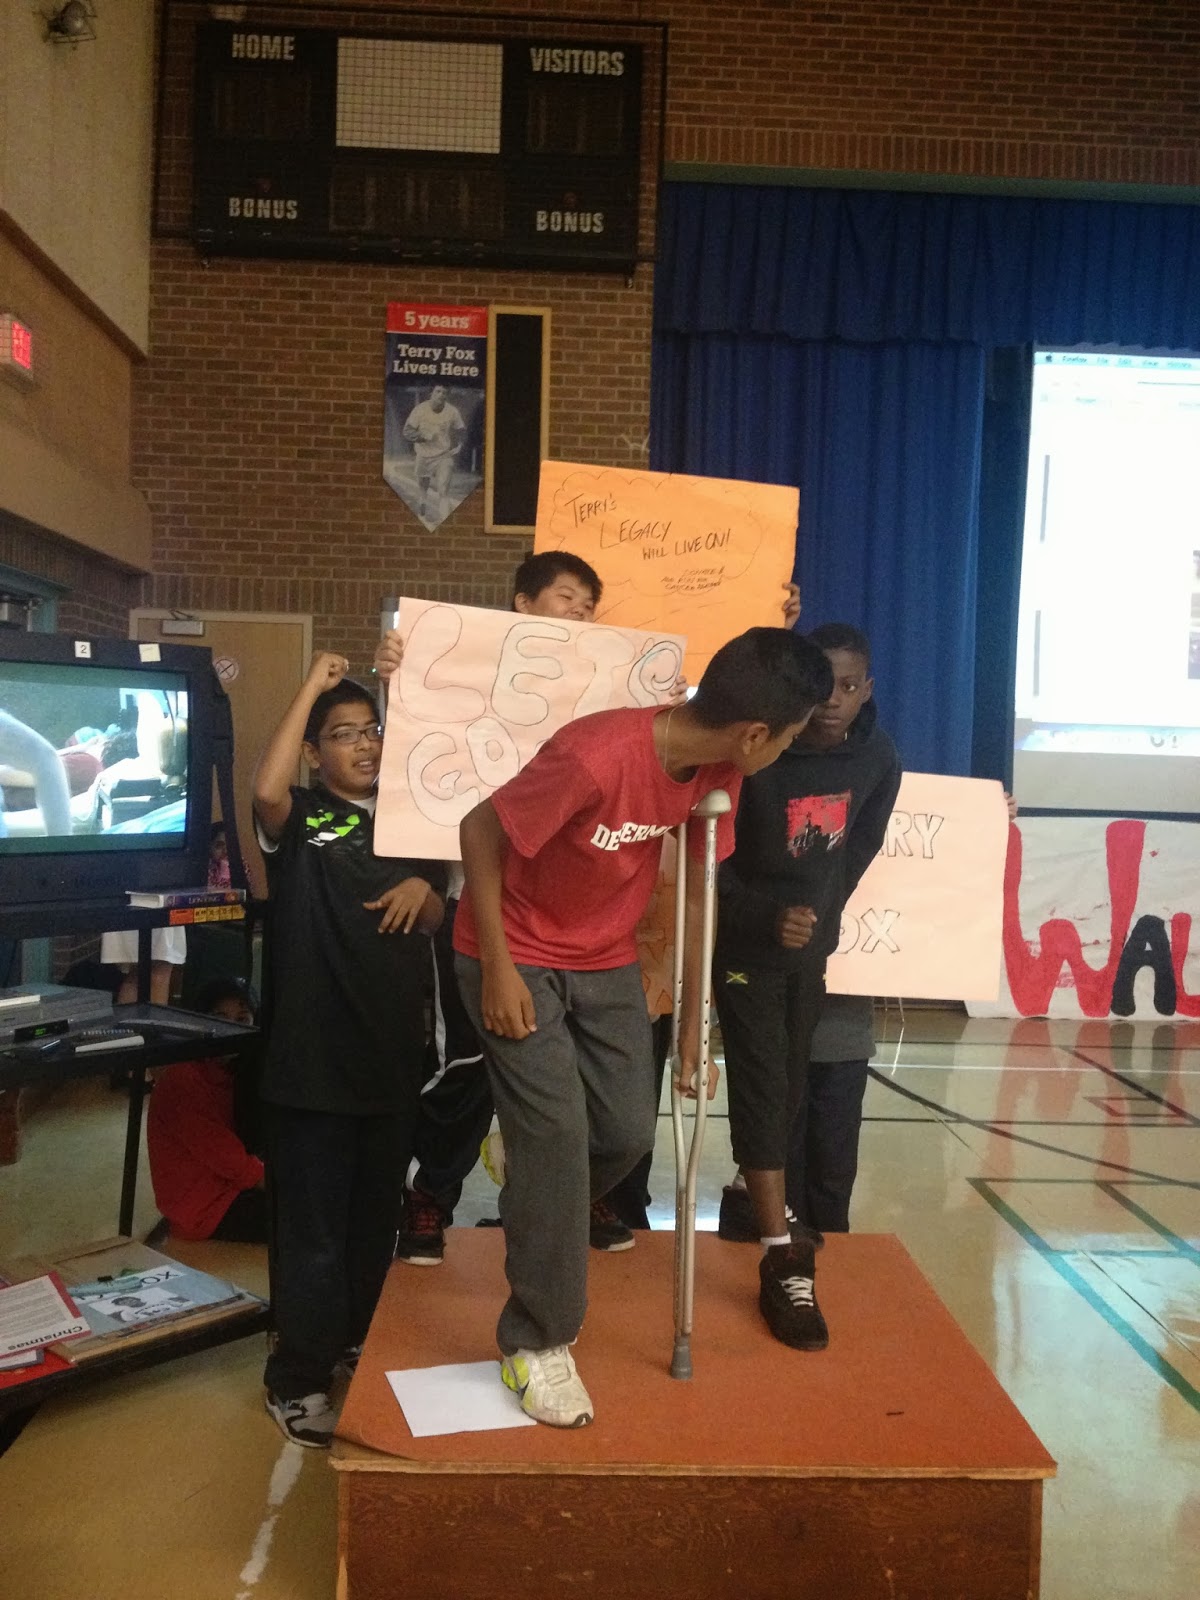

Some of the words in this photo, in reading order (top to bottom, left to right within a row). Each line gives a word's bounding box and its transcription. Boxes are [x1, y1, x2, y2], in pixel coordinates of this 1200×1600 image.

[231, 33, 295, 61] HOME
[530, 47, 625, 76] VISITORS
[228, 197, 298, 220] BONUS
[536, 210, 604, 234] BONUS
[404, 311, 416, 326] 5
[418, 314, 470, 330] years
[398, 344, 443, 361] Terry
[445, 346, 475, 360] Fox
[392, 360, 437, 376] Lives
[440, 362, 479, 377] Here
[600, 519, 672, 549] LEGACY
[642, 547, 670, 560] WILL
[674, 536, 702, 556] LIVE
[704, 528, 731, 552] ON!
[80, 644, 87, 654] 2
[407, 716, 520, 827] GO
[874, 810, 945, 859] RY
[8, 1326, 82, 1350] Christmas
